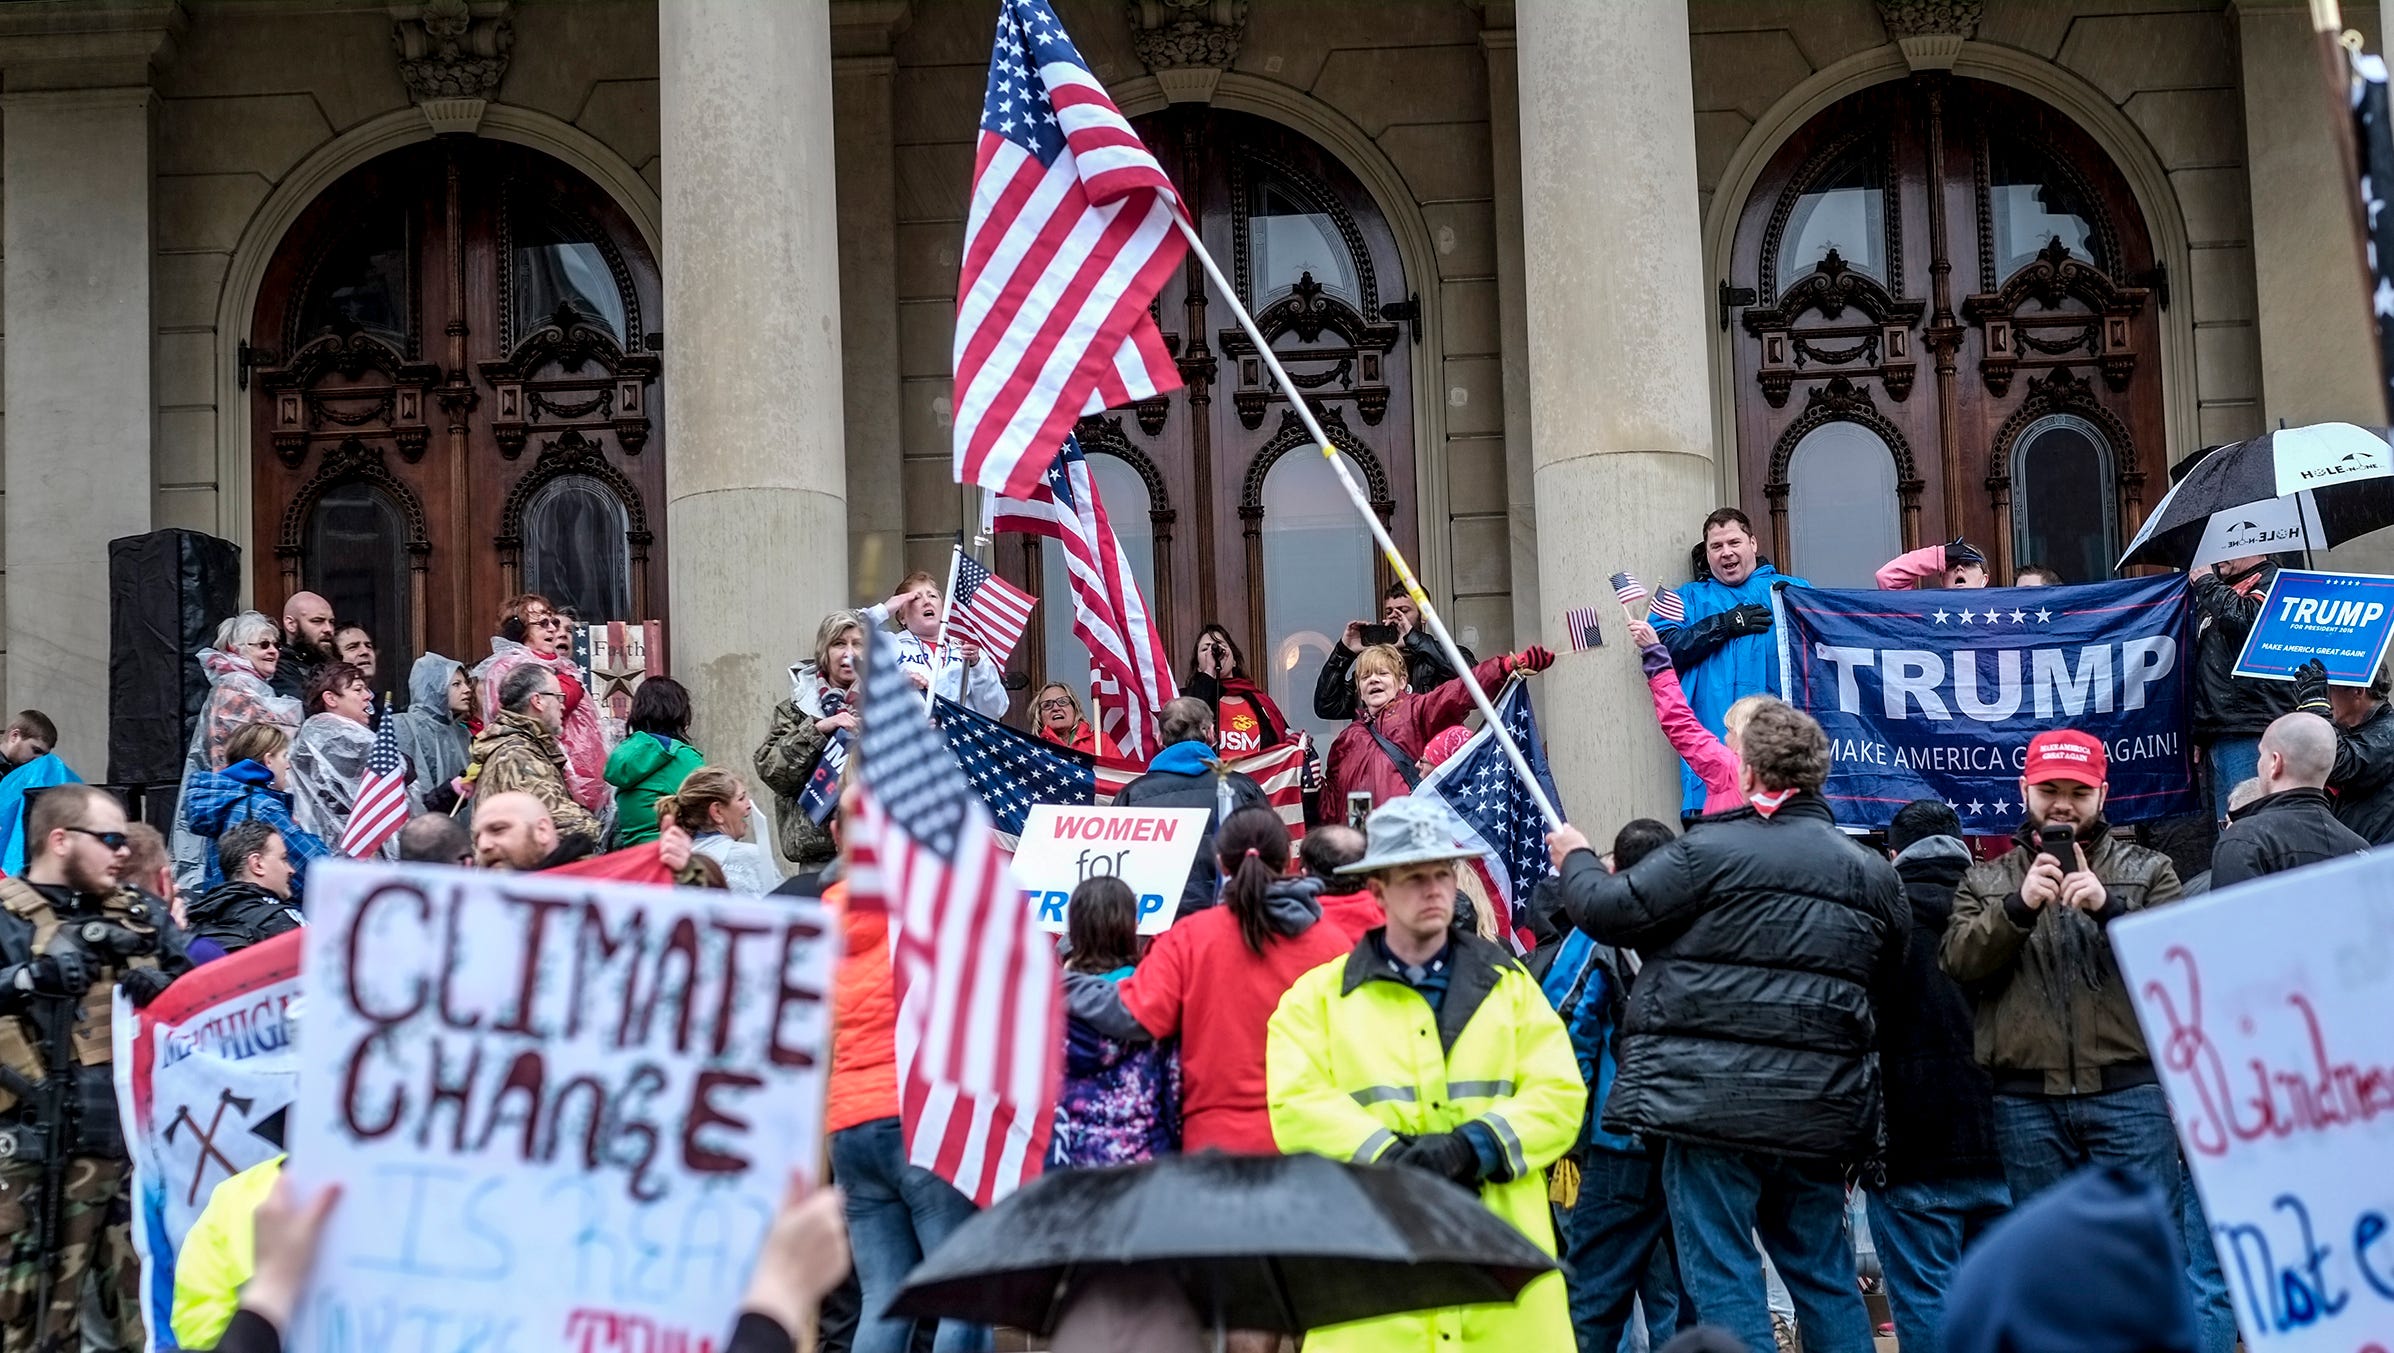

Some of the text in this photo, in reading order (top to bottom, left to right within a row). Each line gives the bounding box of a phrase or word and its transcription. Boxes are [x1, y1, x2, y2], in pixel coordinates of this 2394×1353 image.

[2280, 596, 2384, 628] TRUMP
[2304, 624, 2338, 633] PRESIDENT
[592, 641, 645, 656] Faith
[2261, 642, 2366, 658] MAKE AMERICA GREAT AGAIN!
[1815, 635, 2177, 722] TRUMP
[1829, 737, 1888, 766] MAKE
[1894, 745, 2004, 770] AMERICA
[2103, 731, 2179, 764] AGAIN!
[2059, 743, 2091, 755] AMERICA
[1054, 815, 1179, 842] WOMEN
[1075, 848, 1130, 881] for
[1018, 889, 1164, 925] TRP
[346, 883, 826, 1067] CLIMATE
